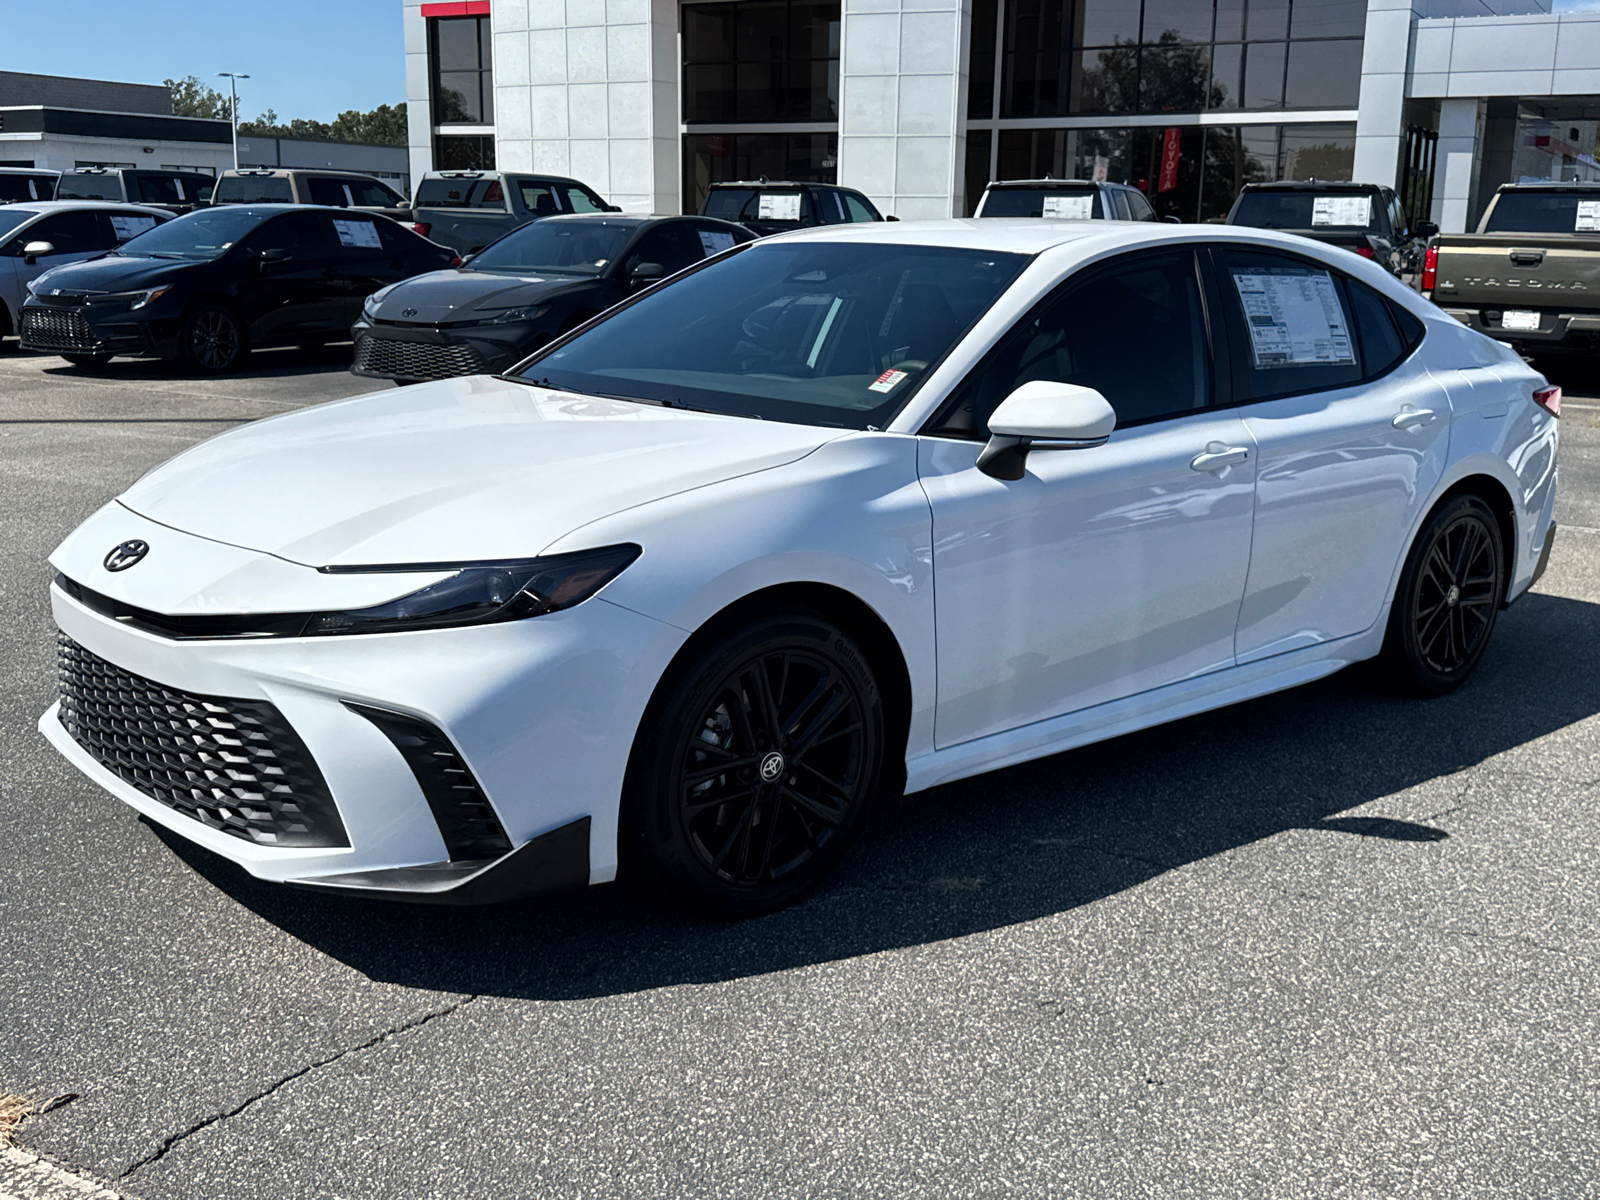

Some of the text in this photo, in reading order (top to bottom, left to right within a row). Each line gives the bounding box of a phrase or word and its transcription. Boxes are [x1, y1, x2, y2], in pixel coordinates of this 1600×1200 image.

[1163, 129, 1176, 189] TOYOTA
[1464, 277, 1588, 290] TACOMA
[834, 639, 872, 688] Continental
